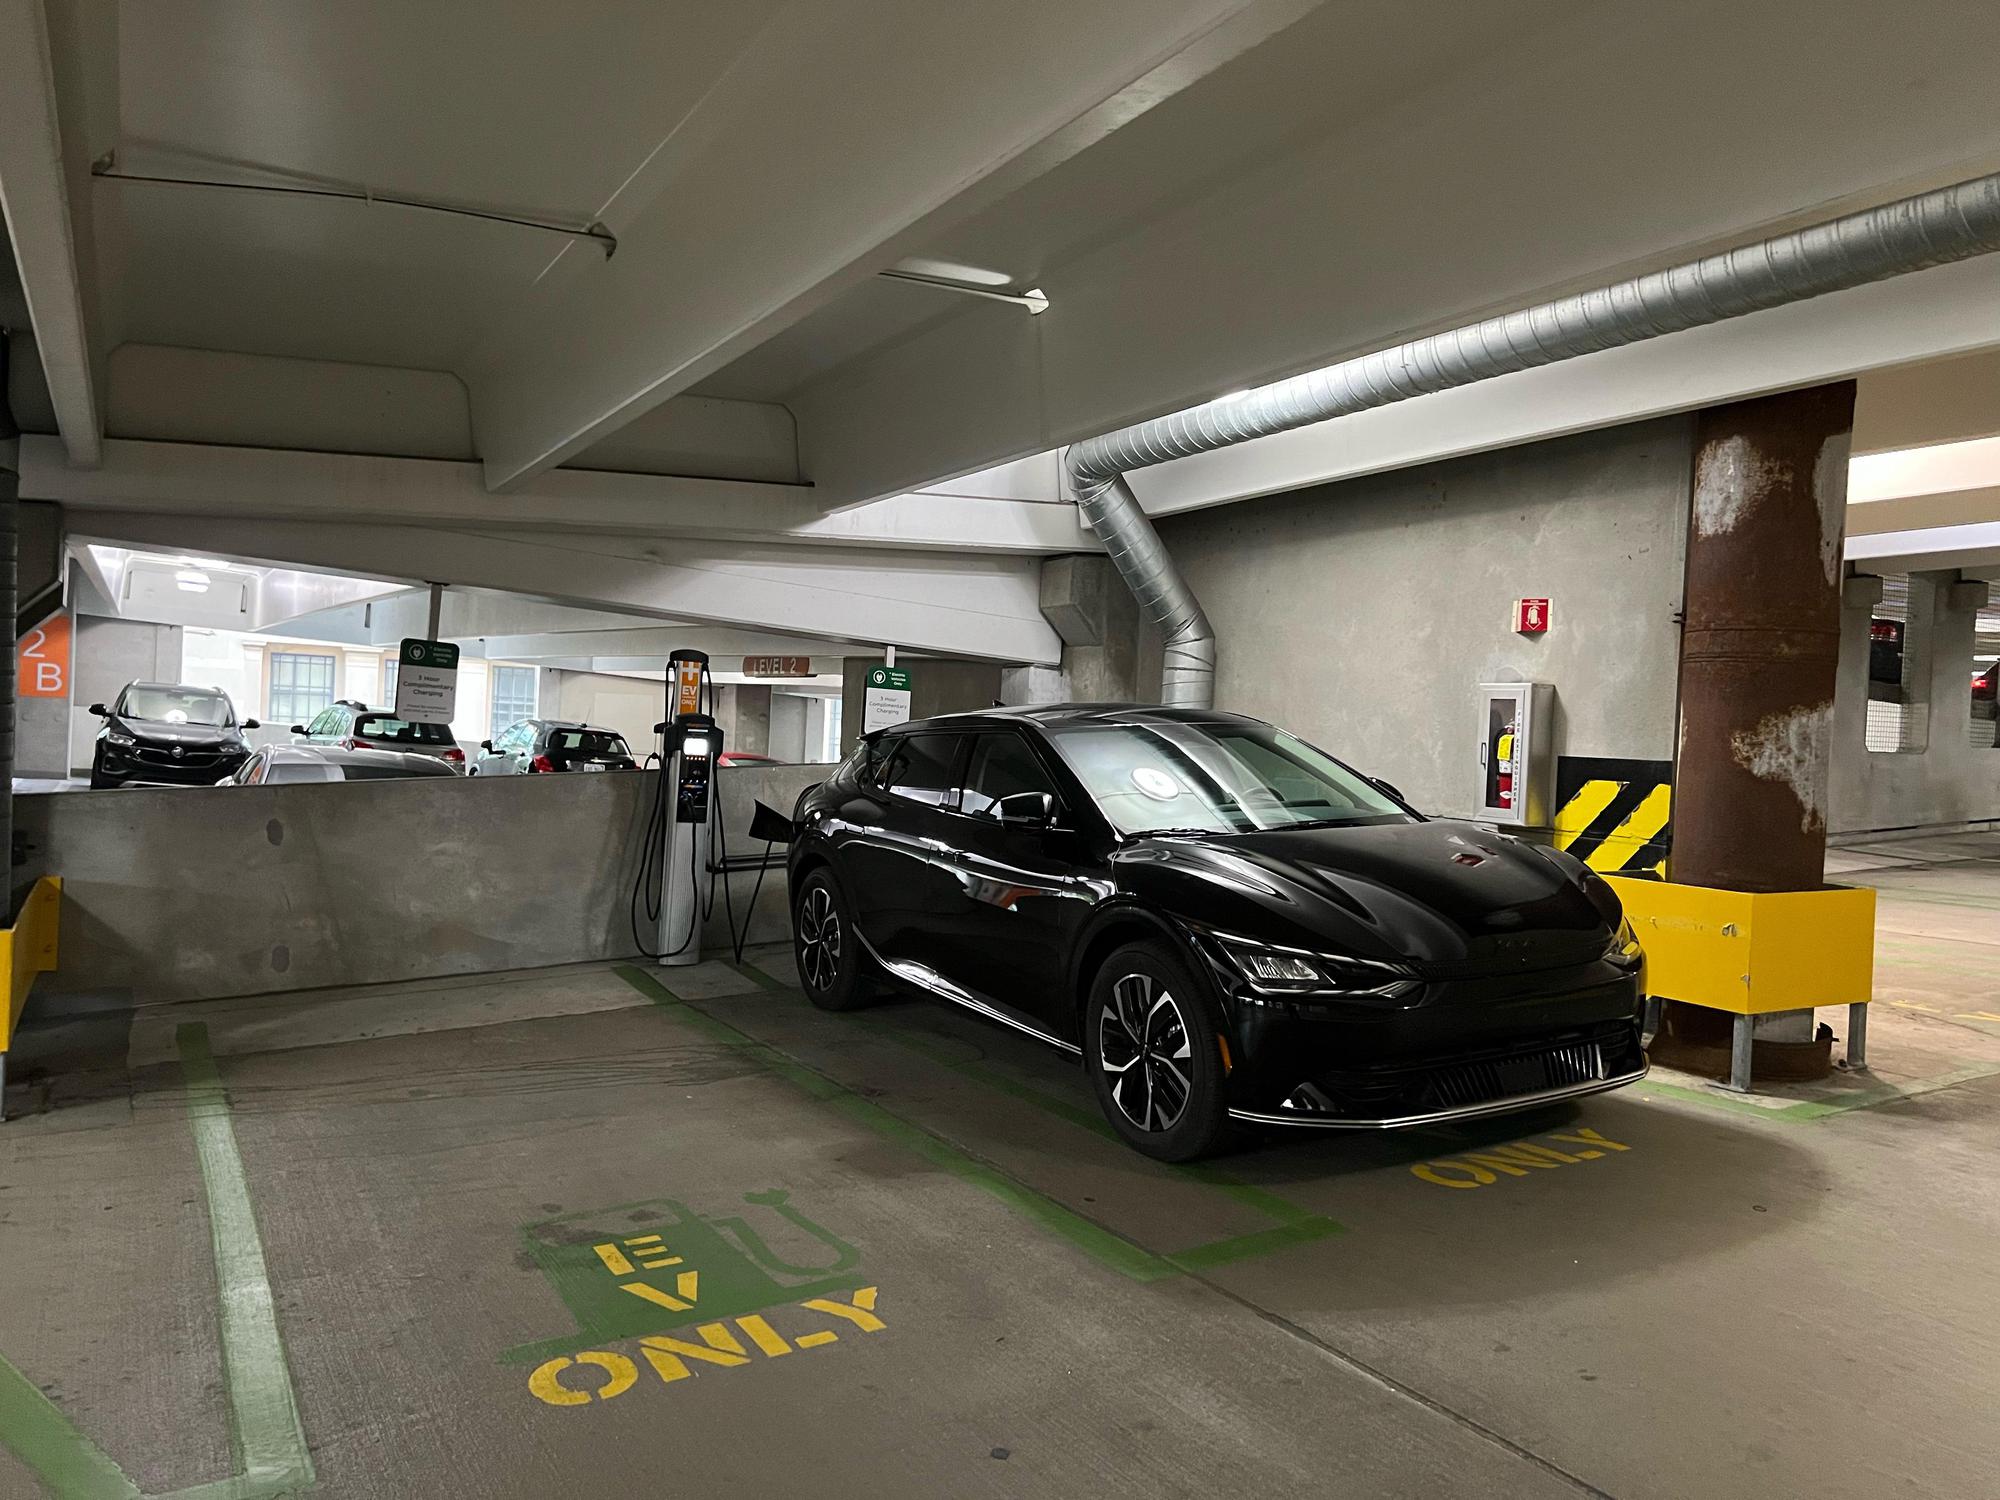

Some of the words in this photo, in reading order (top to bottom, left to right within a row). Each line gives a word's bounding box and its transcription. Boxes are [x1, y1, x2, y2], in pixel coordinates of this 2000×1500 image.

[22, 630, 46, 658] 2
[36, 662, 63, 692] B
[753, 657, 785, 675] LEVEL
[790, 657, 797, 674] 2
[682, 686, 697, 695] EV
[1410, 1128, 1632, 1189] ONLY
[592, 1233, 699, 1312] EV
[527, 1285, 889, 1407] ONLY
